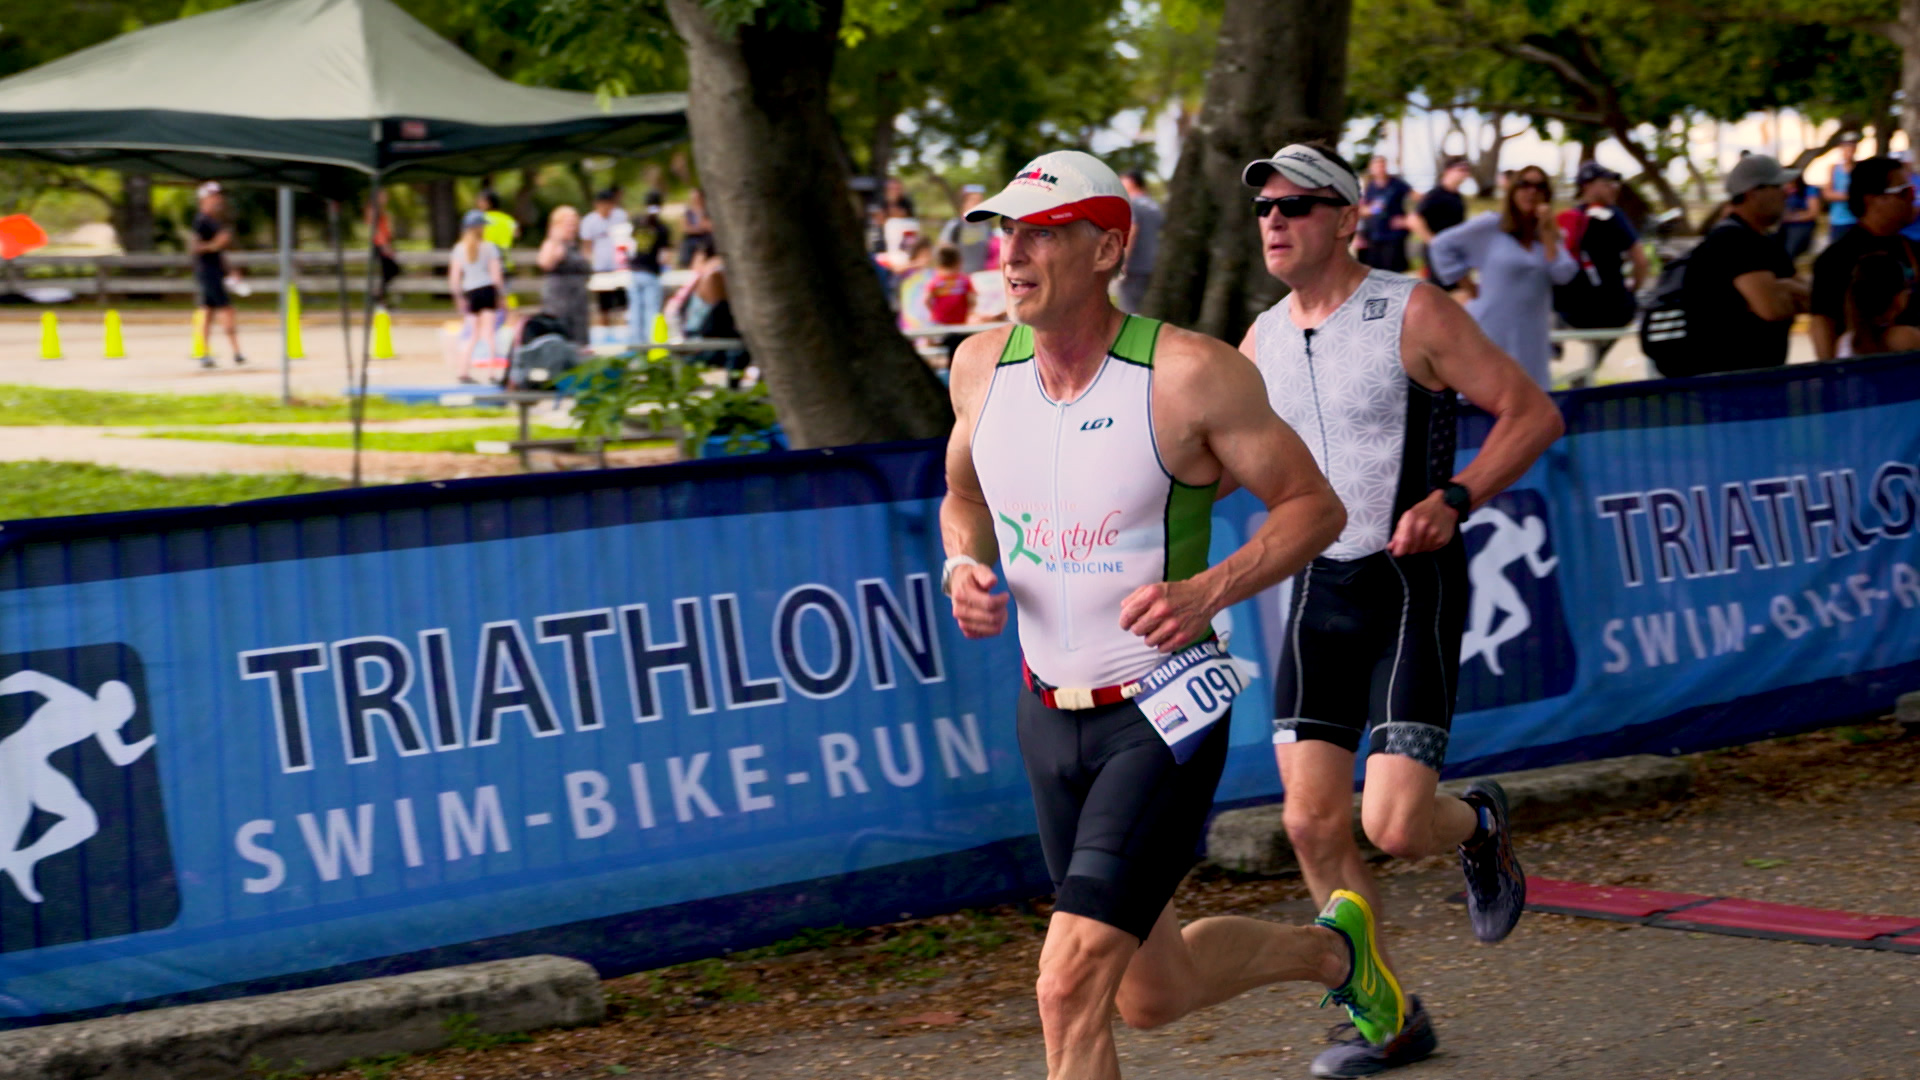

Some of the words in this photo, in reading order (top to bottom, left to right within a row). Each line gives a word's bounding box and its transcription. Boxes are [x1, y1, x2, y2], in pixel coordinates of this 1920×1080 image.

[1045, 561, 1124, 574] MEDICINE
[1597, 461, 1920, 587] TRIATHLO
[238, 573, 946, 774] TRIATHLON
[234, 713, 988, 894] SWIM-BIKE-RUN
